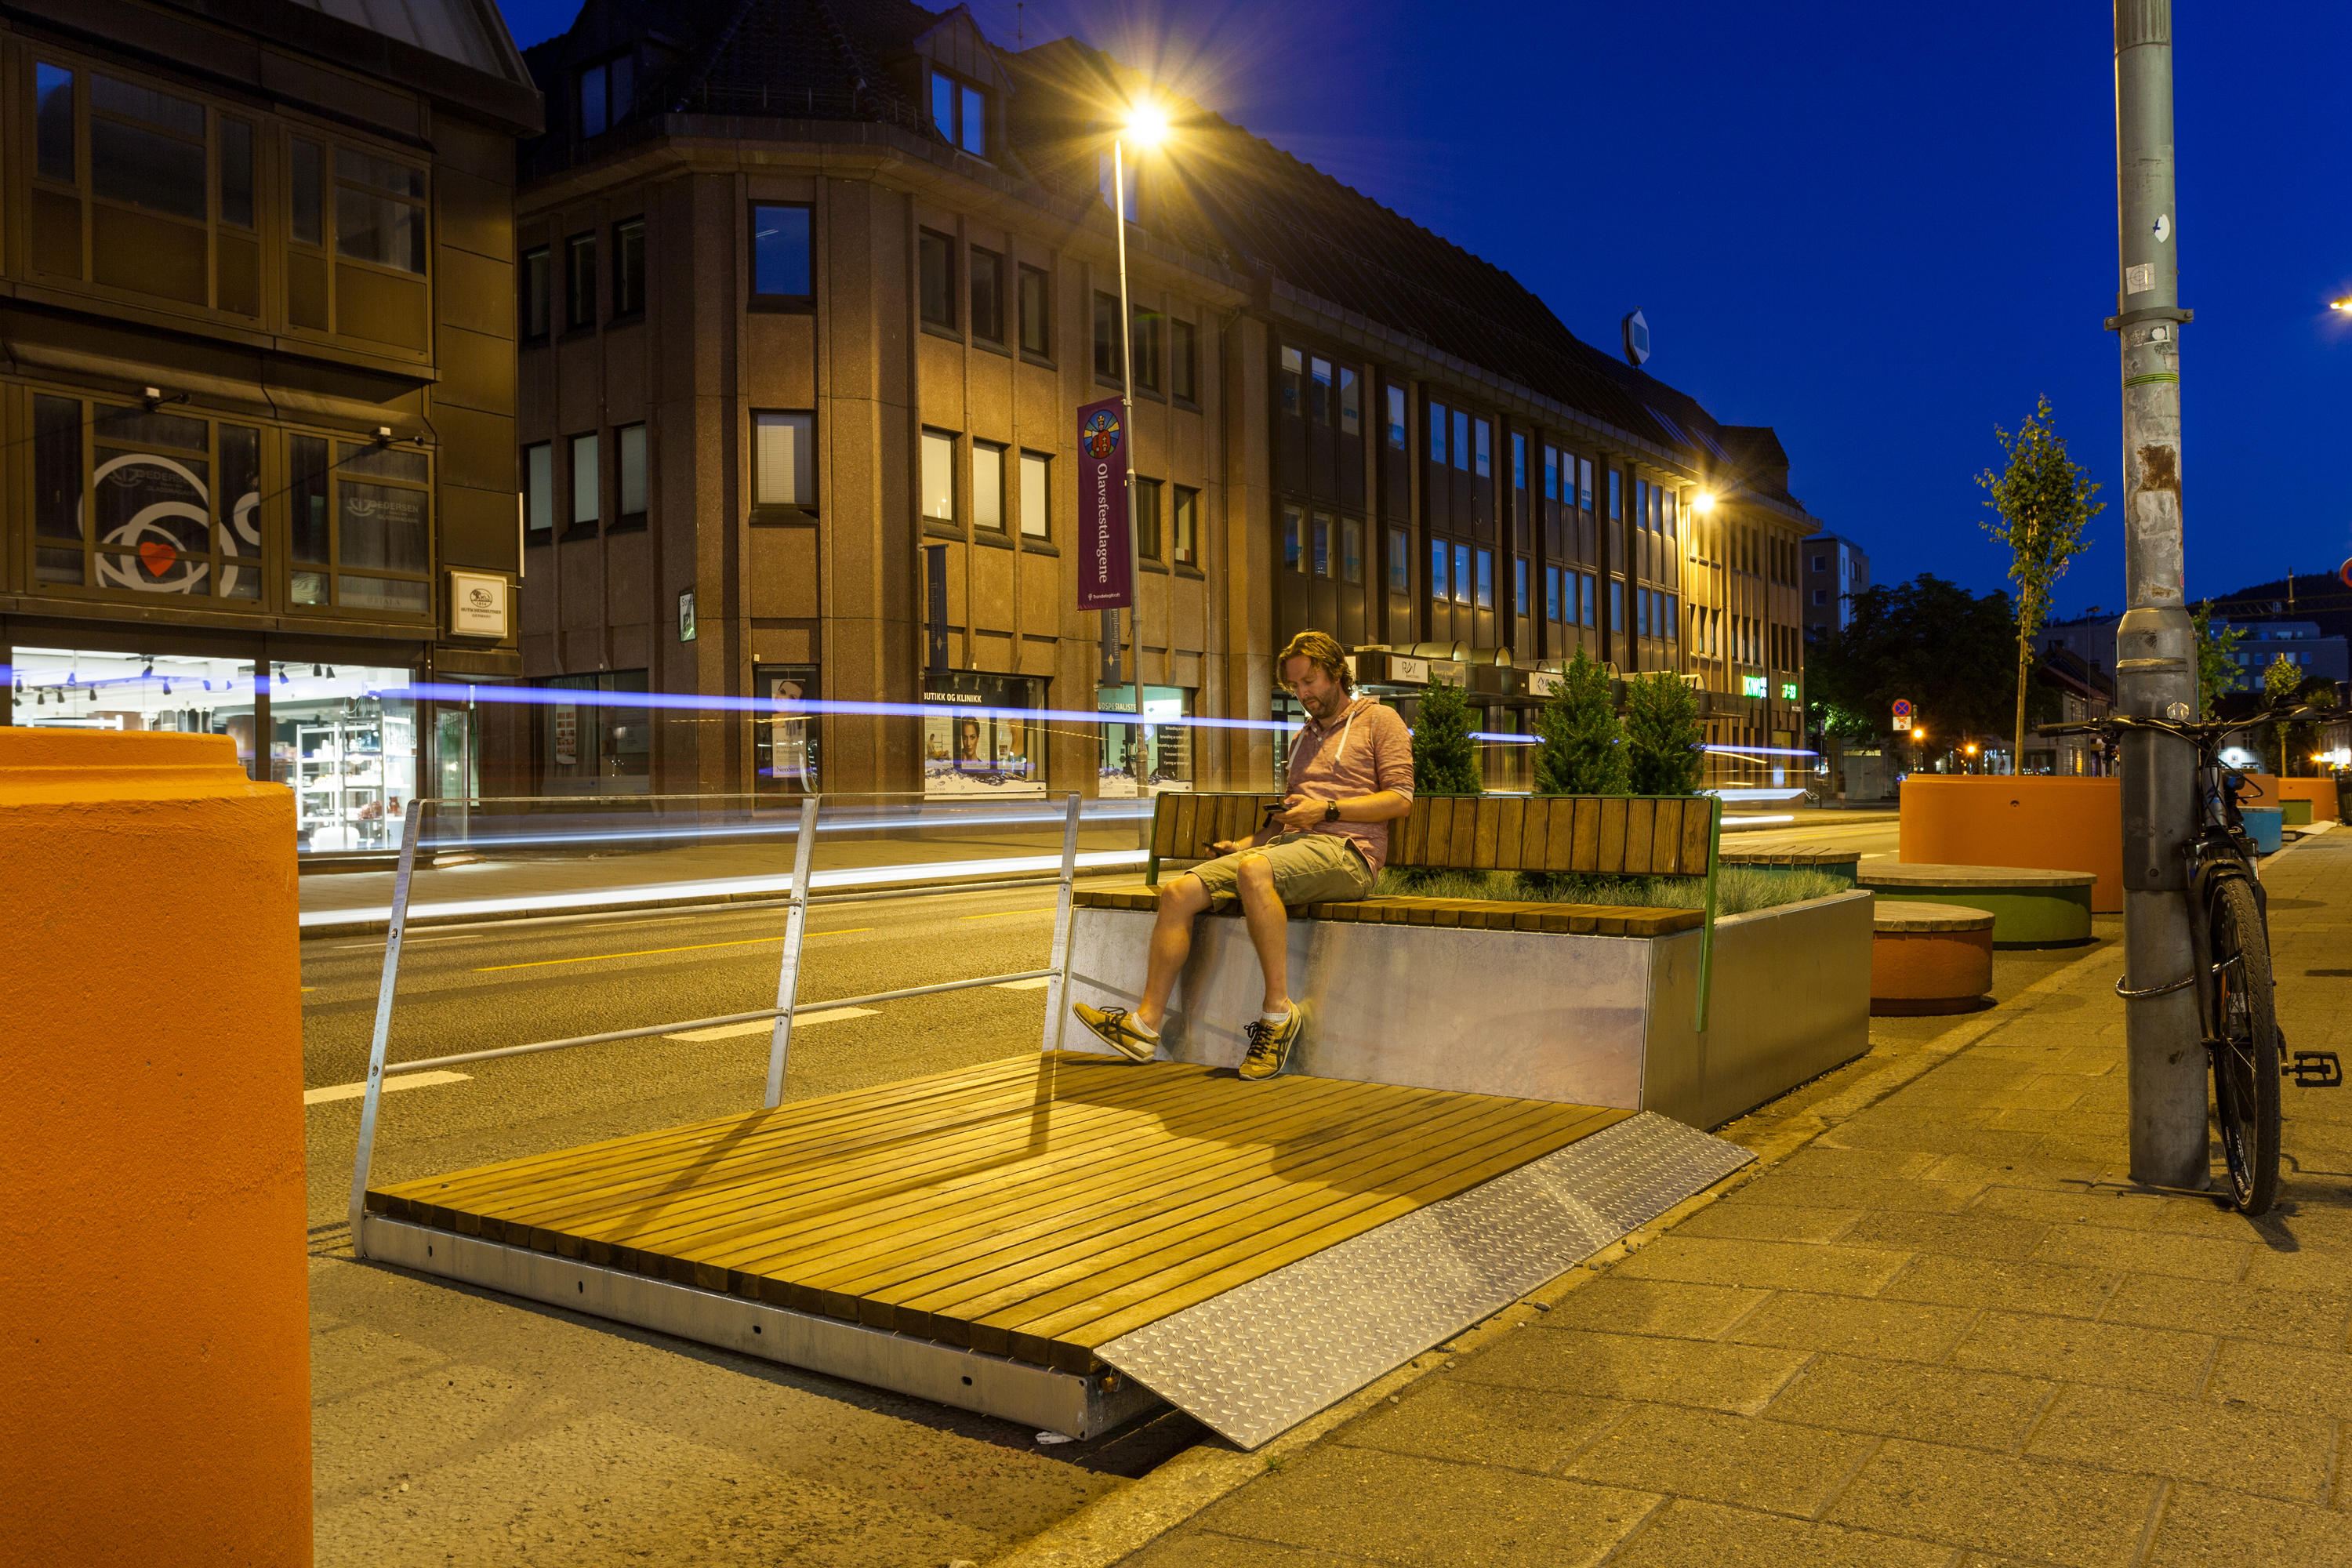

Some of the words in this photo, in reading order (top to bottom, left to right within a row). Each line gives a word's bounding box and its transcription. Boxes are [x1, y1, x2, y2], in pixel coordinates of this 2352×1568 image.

[1097, 463, 1110, 583] Olavsfestdagene
[1746, 677, 1761, 696] KIWI
[924, 692, 946, 701] BUTIKK
[946, 693, 956, 702] OG
[957, 694, 982, 702] KLINIKK
[1098, 702, 1136, 711] UDSPESIALISTE
